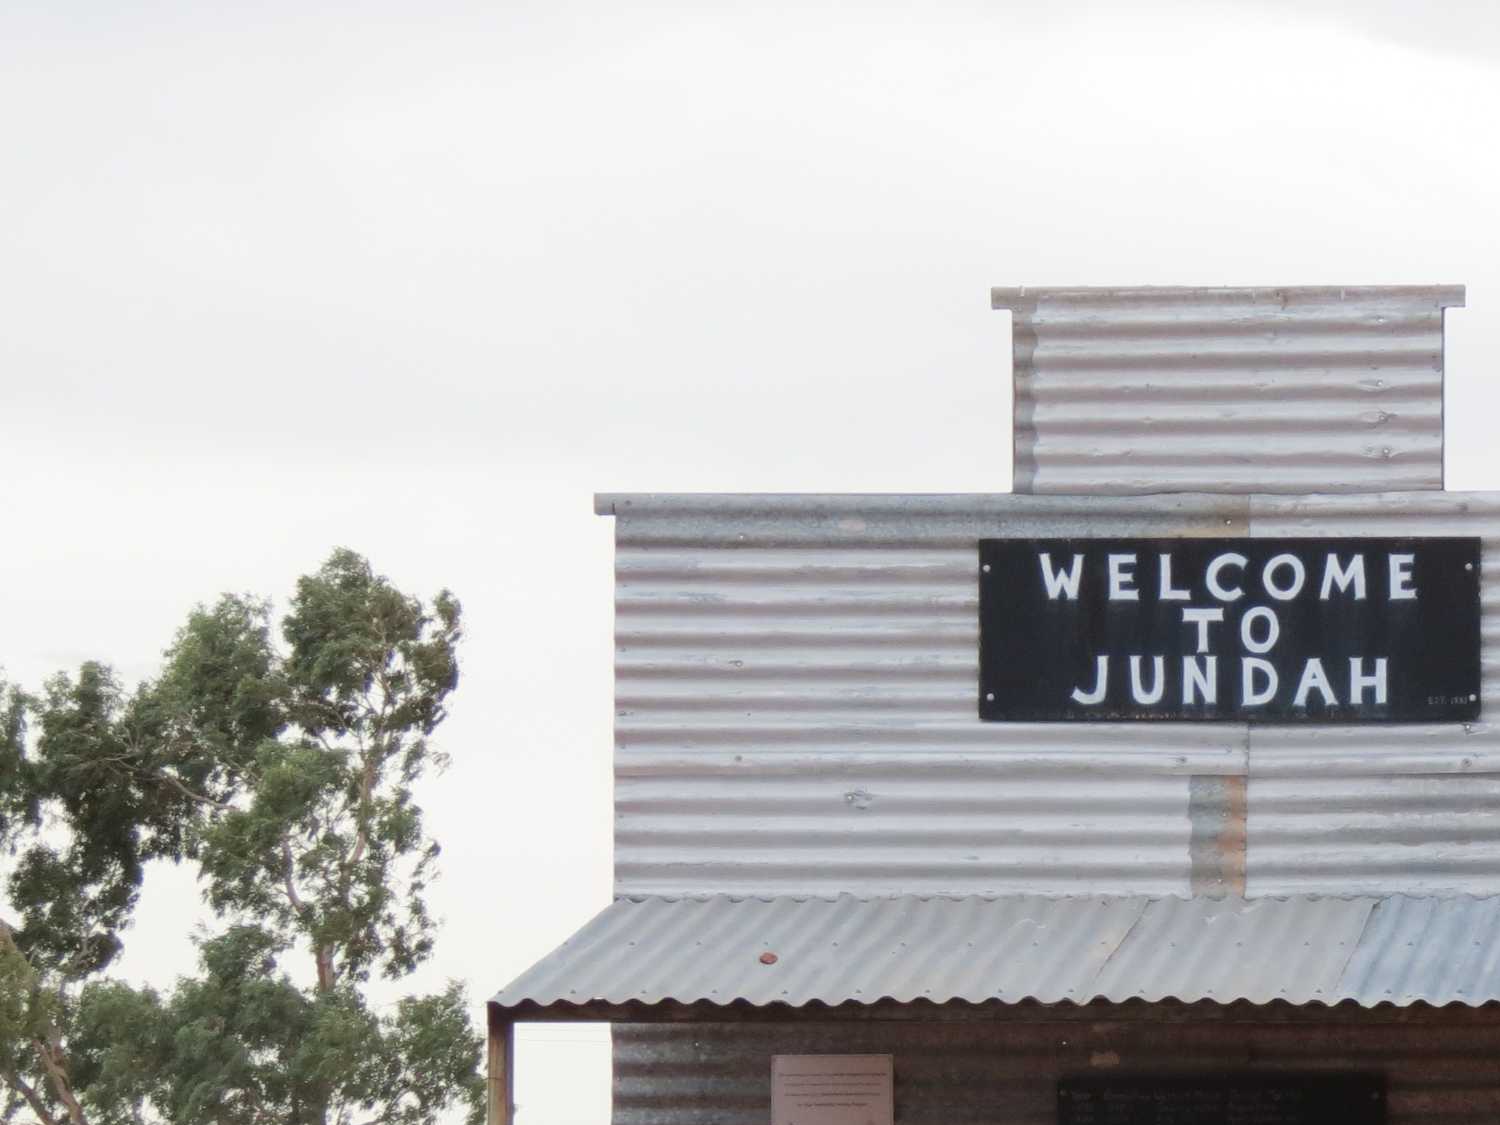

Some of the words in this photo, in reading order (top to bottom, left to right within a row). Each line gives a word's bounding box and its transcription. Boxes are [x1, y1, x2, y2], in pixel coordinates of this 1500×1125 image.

[1039, 553, 1418, 600] WELCOME
[1182, 606, 1280, 654] TO
[1071, 655, 1389, 707] JUNDAH
